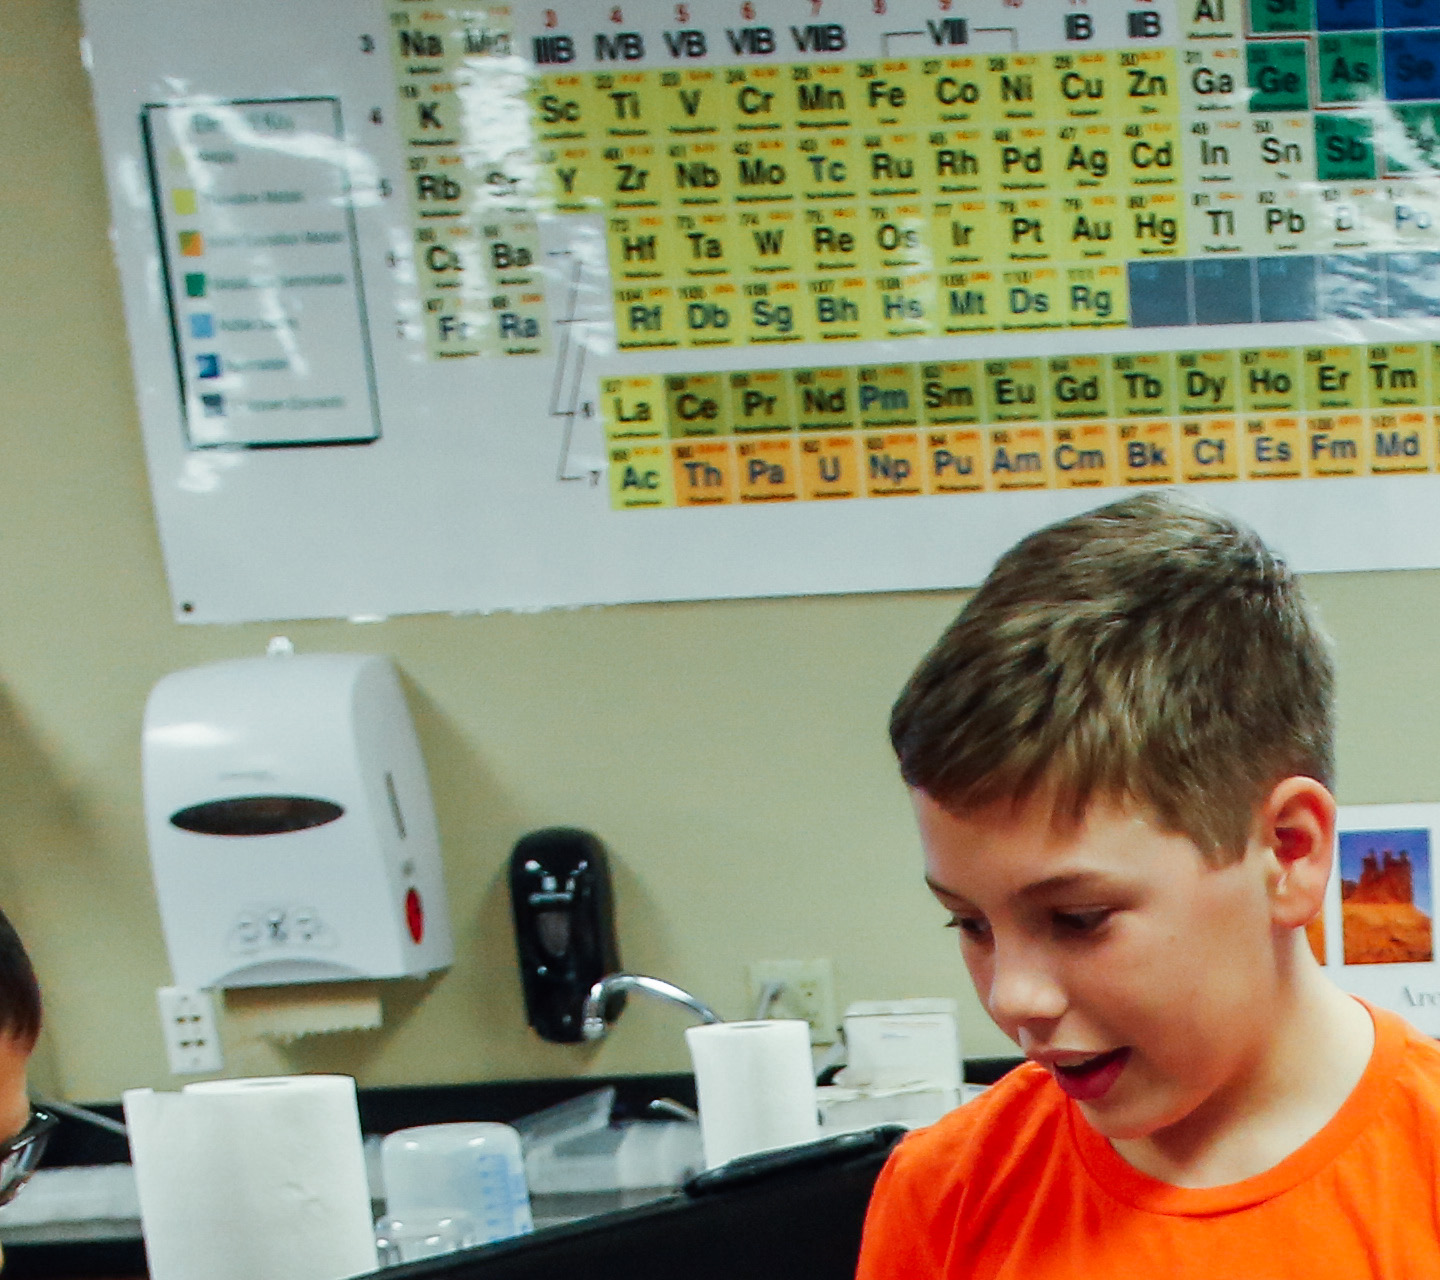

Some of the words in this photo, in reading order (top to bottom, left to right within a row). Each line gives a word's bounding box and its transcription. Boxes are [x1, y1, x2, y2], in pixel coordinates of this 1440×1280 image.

[419, 102, 441, 128] K
[540, 95, 579, 123] Sc
[608, 92, 640, 119] Ti
[680, 89, 701, 117] V
[737, 85, 774, 113] Cr
[799, 83, 845, 110] Mn
[869, 81, 906, 108] Fe
[936, 77, 979, 104] Co
[1002, 74, 1032, 101] Ni
[1062, 72, 1103, 99] Cu
[1128, 69, 1166, 96] Zn
[1193, 67, 1232, 94] Ga
[557, 167, 576, 193] Y
[616, 164, 648, 191] Zr
[740, 159, 785, 185] Mo
[809, 155, 846, 182] Tc
[872, 153, 912, 179] Ru
[938, 150, 978, 175] Rh
[1002, 146, 1042, 173] Pd
[1067, 144, 1108, 177] Ag
[1132, 142, 1172, 168] Cd
[1201, 139, 1228, 165] In
[1262, 137, 1300, 164] Sn
[686, 232, 723, 259] Ta
[754, 229, 784, 255] W
[815, 226, 855, 252] Re
[953, 221, 974, 245] Ir
[1013, 217, 1043, 243] Pt
[1073, 216, 1111, 241] Au
[1136, 212, 1177, 244] Hg
[1266, 208, 1304, 234] Pb
[615, 396, 650, 422] La
[677, 393, 719, 420] Ce
[743, 390, 777, 417] Pr
[995, 379, 1036, 404] Eu
[1055, 375, 1099, 402] Gd
[1123, 371, 1160, 398] Tb
[1188, 370, 1226, 403] Dy
[1249, 368, 1291, 394] Ho
[1319, 365, 1350, 391] Er
[1369, 363, 1416, 389] Tm
[622, 466, 659, 491] Ac
[683, 462, 722, 487] Th
[749, 459, 785, 485] Pa
[819, 456, 840, 482] U
[933, 450, 972, 476] Pu
[993, 446, 1041, 474] Am
[1055, 444, 1104, 470] Cm
[1256, 437, 1291, 462] Es
[1312, 433, 1357, 460] Fm
